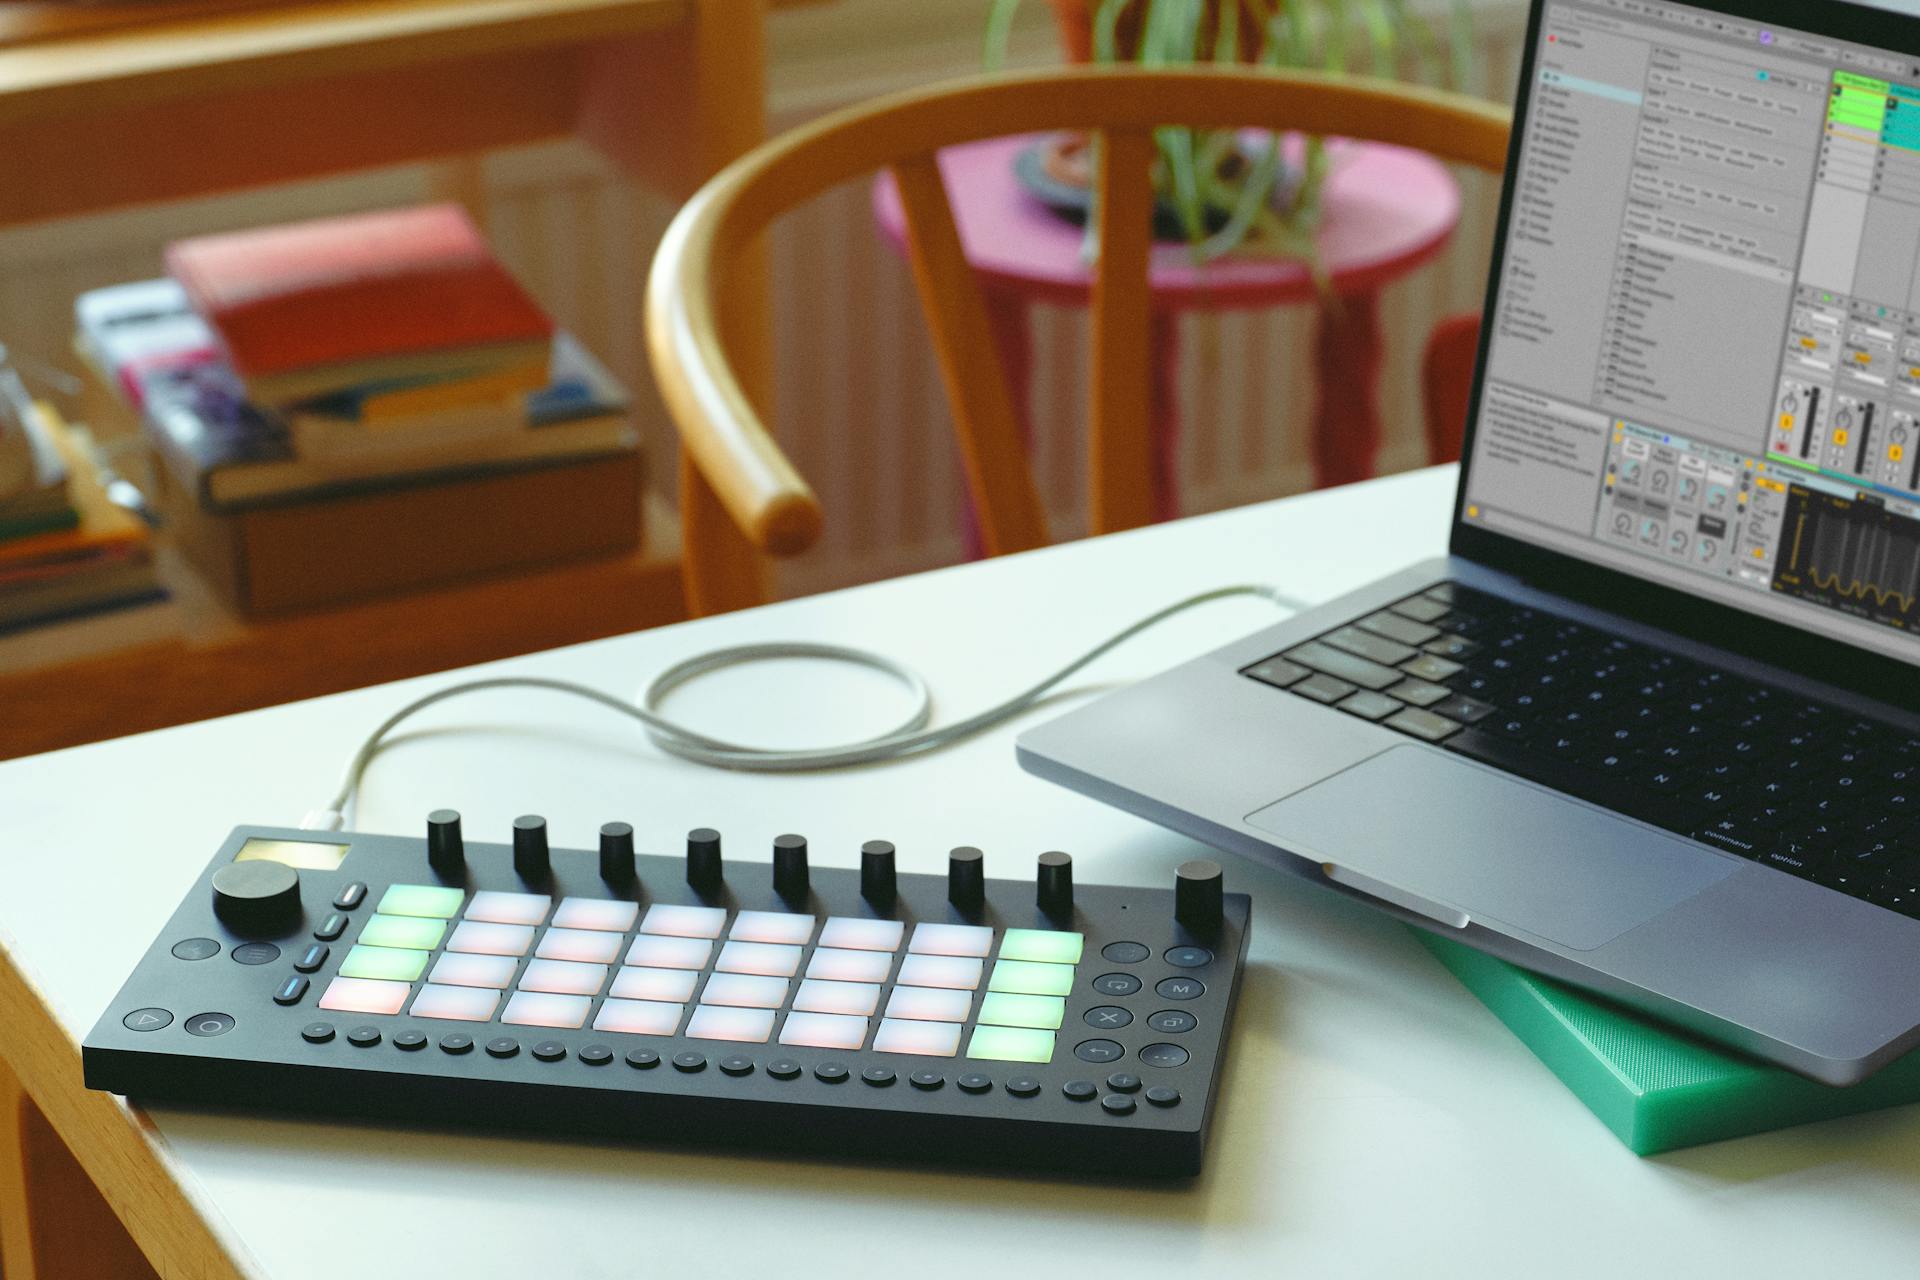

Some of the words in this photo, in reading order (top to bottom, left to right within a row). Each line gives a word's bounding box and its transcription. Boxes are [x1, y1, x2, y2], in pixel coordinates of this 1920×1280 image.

[1704, 830, 1753, 850] command
[1770, 852, 1803, 868] option
[1172, 984, 1190, 993] M
